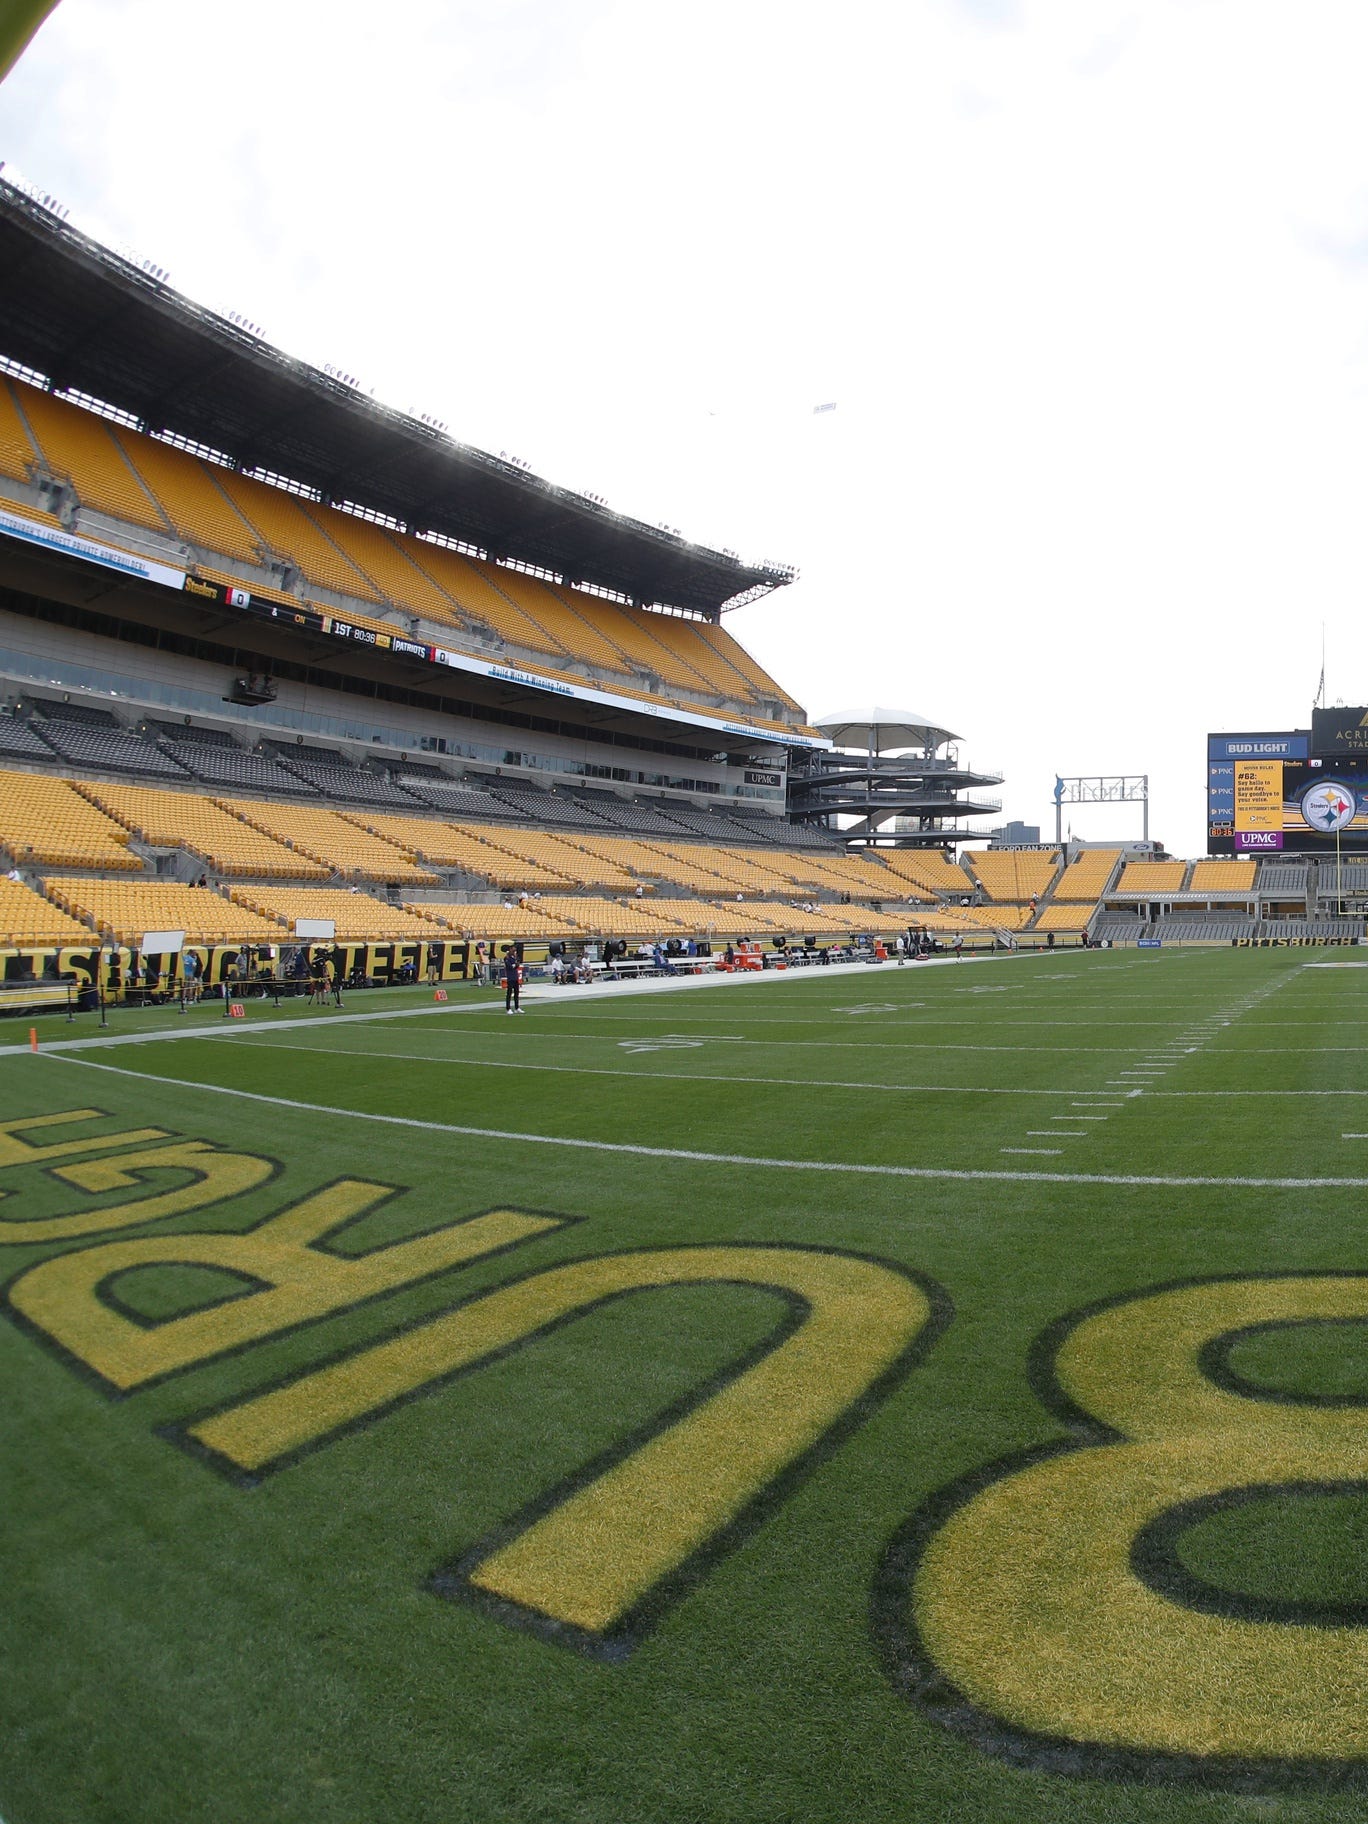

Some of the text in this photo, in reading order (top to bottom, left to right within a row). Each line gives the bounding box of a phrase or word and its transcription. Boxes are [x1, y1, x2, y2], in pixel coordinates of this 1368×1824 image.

[185, 576, 218, 600] Steelers
[237, 594, 244, 604] 0
[272, 607, 278, 617] &
[334, 622, 352, 637] 1ST
[354, 630, 376, 644] 80:36
[395, 640, 426, 659] PATRIOTS
[439, 652, 445, 662] 0
[1228, 744, 1287, 753] BUD LIGHT
[752, 773, 776, 784] UPMC
[1241, 833, 1277, 843] UPMC
[1237, 937, 1352, 948] PITTSBURGH
[235, 1005, 243, 1015] 10
